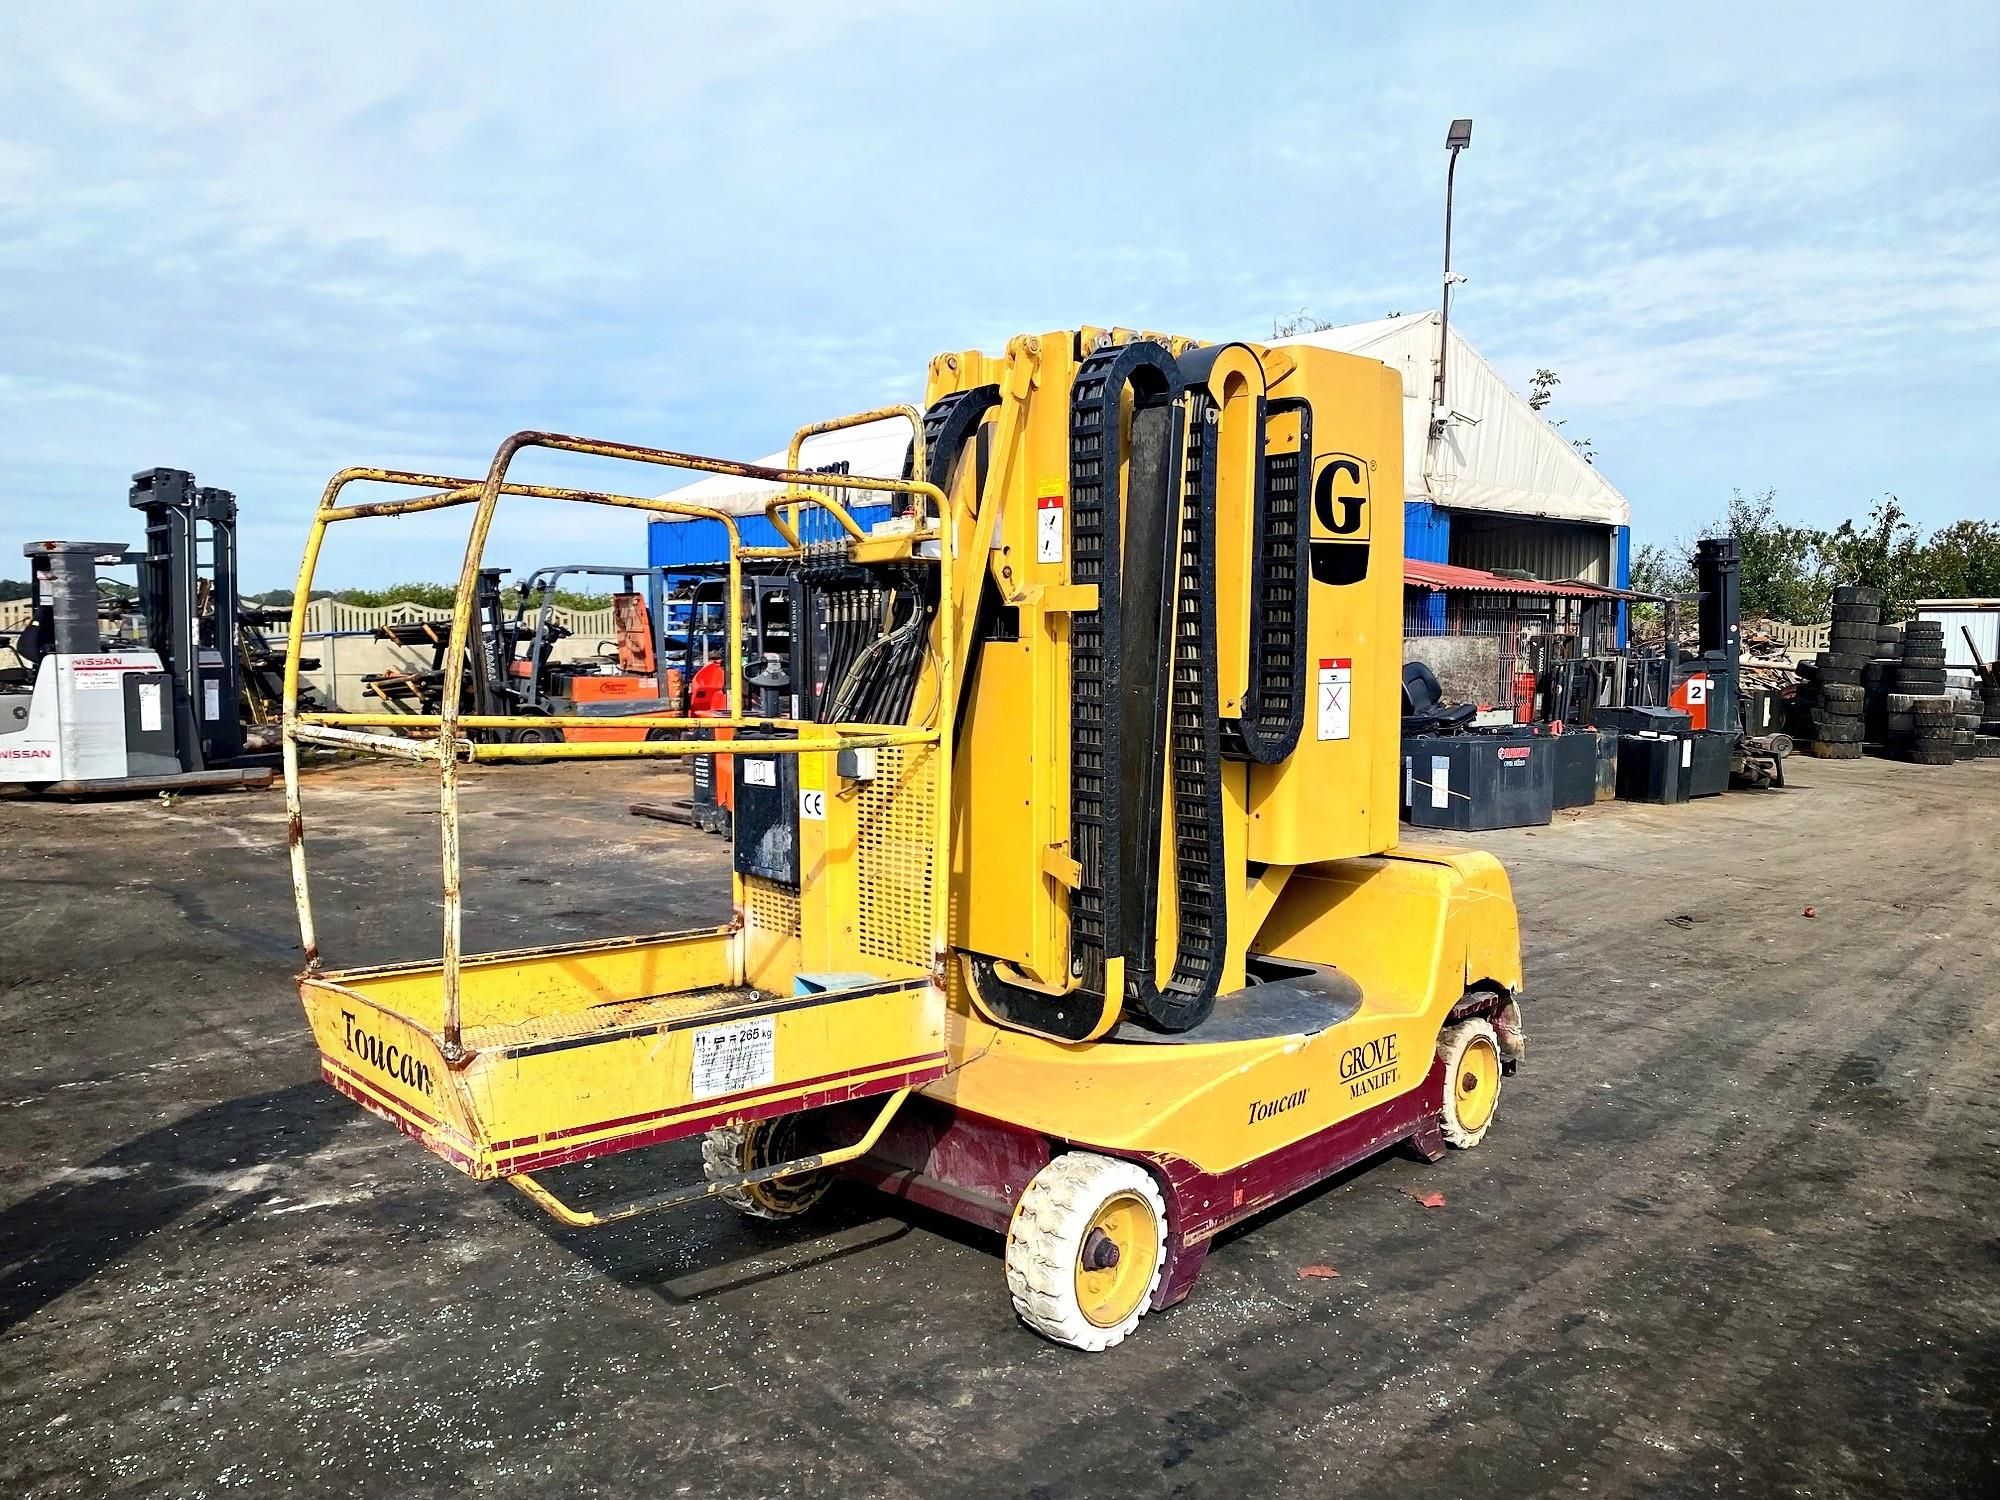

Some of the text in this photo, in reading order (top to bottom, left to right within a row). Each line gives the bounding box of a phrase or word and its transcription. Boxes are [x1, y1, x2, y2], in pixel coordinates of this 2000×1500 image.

[1315, 460, 1366, 534] G
[72, 657, 122, 666] NISSAN
[482, 639, 496, 681] TOYOTA
[1691, 686, 1702, 699] 2
[0, 750, 51, 759] NISSAN
[341, 1007, 433, 1097] Toucan
[740, 1028, 772, 1043] 265 kg
[1340, 1033, 1397, 1079] GROVE
[1350, 1067, 1398, 1100] MANLIFT
[1248, 1087, 1308, 1126] Toucan
